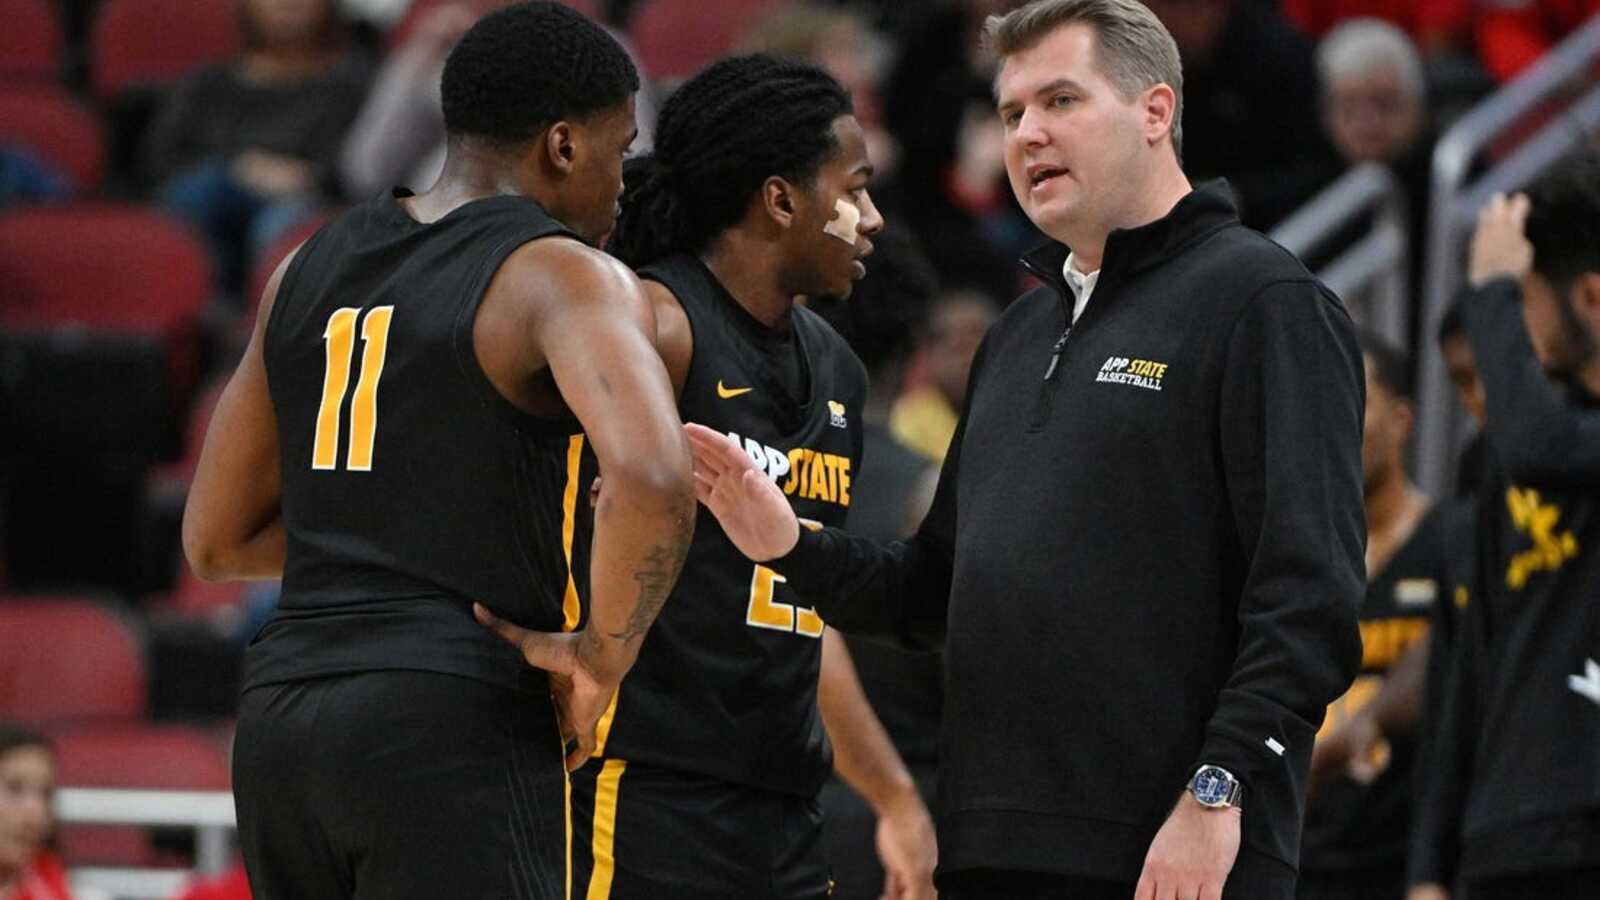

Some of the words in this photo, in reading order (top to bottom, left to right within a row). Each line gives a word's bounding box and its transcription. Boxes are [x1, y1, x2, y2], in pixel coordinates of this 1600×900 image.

[312, 305, 394, 471] 11
[1096, 371, 1162, 391] BASKETBALL
[1100, 356, 1130, 372] APP
[1127, 359, 1168, 378] STATE
[728, 432, 790, 483] PP
[783, 448, 850, 507] STATE
